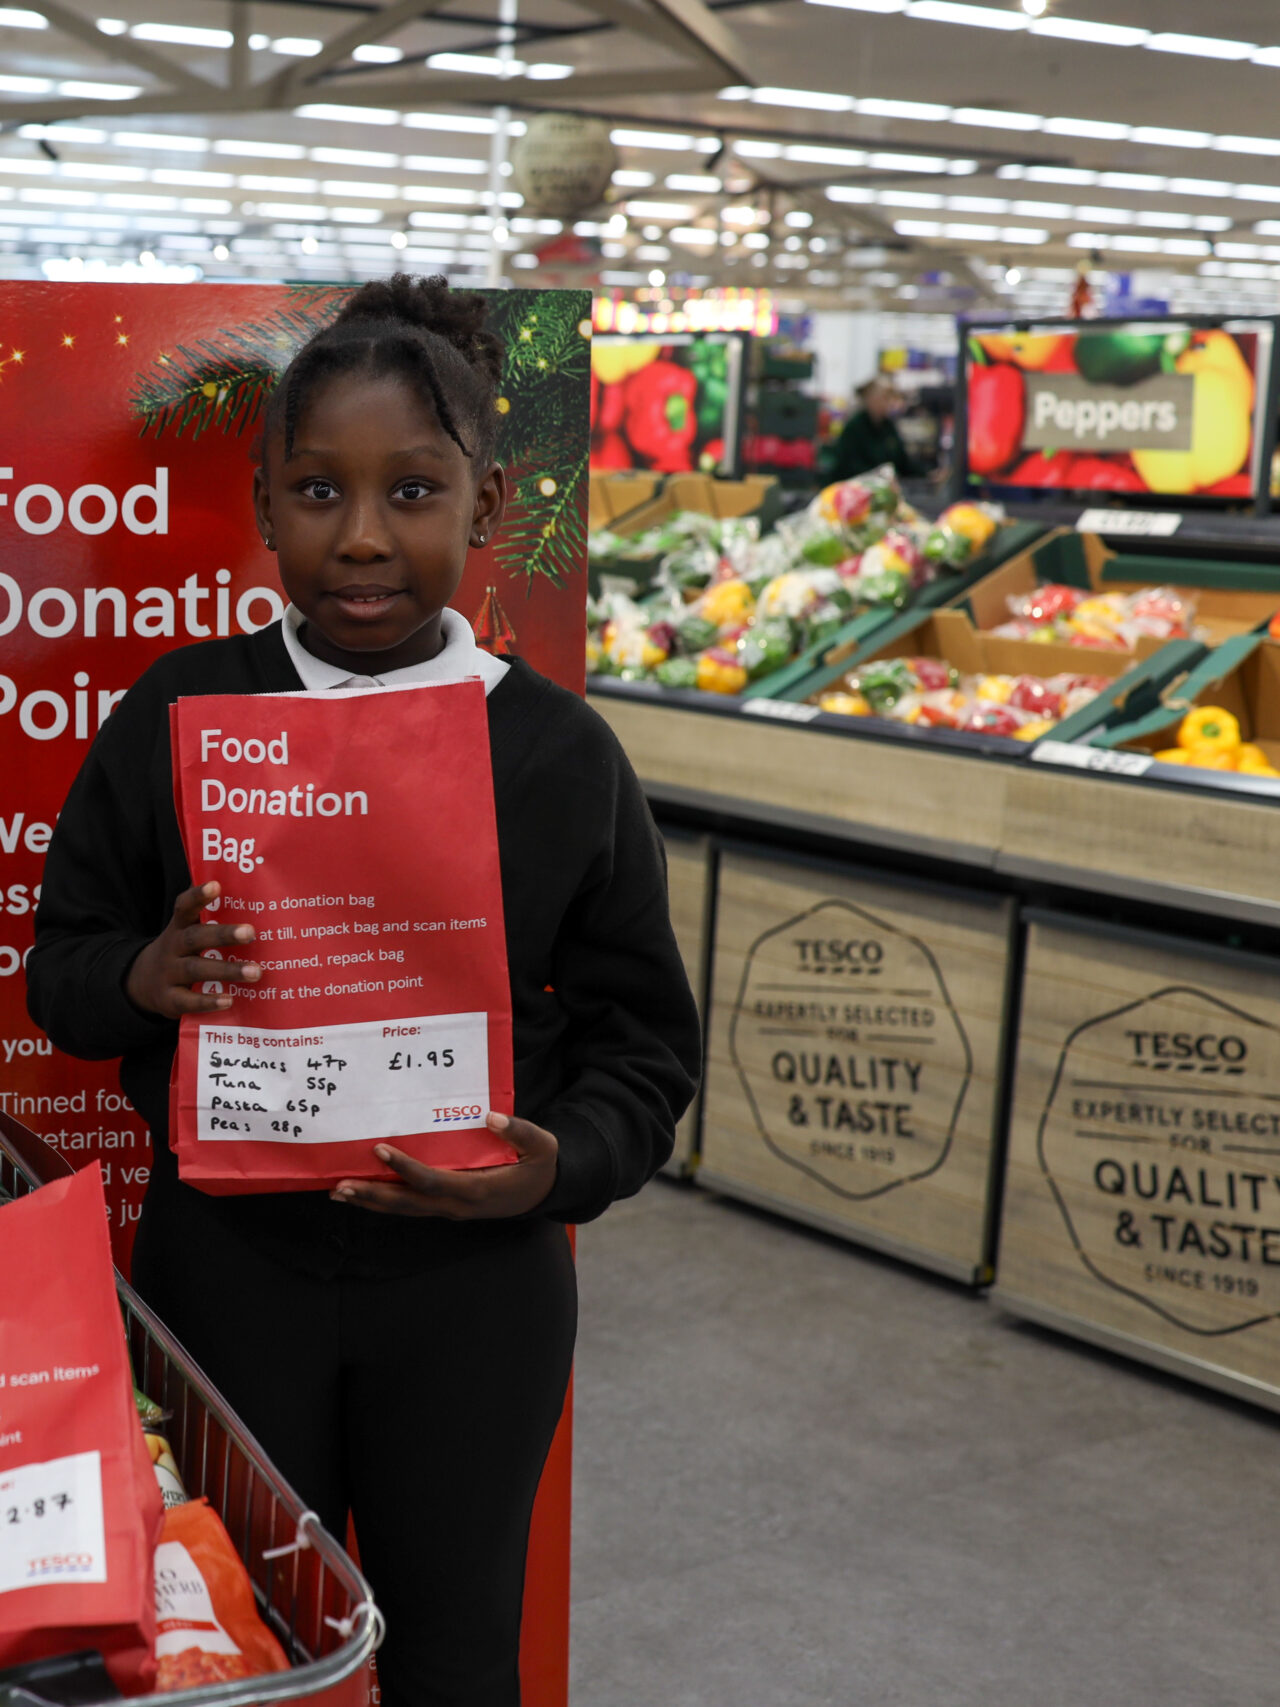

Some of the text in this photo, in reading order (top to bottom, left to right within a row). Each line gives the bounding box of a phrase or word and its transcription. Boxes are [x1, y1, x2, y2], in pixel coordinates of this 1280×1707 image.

[1034, 391, 1177, 438] Peppers
[200, 728, 289, 765] Food
[200, 779, 368, 817] Donation
[201, 828, 265, 874] Bag.
[224, 894, 375, 914] Pick up a donation bag
[259, 917, 487, 941] at unpack bag and scan items
[326, 949, 405, 967] repack bag
[792, 939, 883, 965] TESCO
[229, 976, 424, 1001] Drop off at the donation point
[754, 1000, 936, 1028] EXPERTLY SELECTED
[205, 1025, 421, 1048] This bag contains: Price:
[1124, 1030, 1249, 1063] TESCO
[2, 1036, 53, 1063] you
[209, 1049, 455, 1073] Sardines 47p £1.95
[208, 1073, 337, 1096] Tuna 55p
[772, 1050, 924, 1095] QUALITY
[211, 1096, 321, 1117] Pasta 65p
[432, 1104, 482, 1120] TESCO
[787, 1093, 915, 1139] & TASTE
[1072, 1099, 1280, 1136] EXPERTLY SELECT
[210, 1117, 302, 1138] Peas 28p
[810, 1140, 895, 1164] SINCE 1919
[1169, 1133, 1212, 1154] FOR
[1114, 1209, 1280, 1266] & TASTE
[1144, 1263, 1259, 1298] SINCE 1919
[9, 1369, 50, 1387] scan
[53, 1363, 101, 1382] items
[28, 1553, 94, 1570] TESCO
